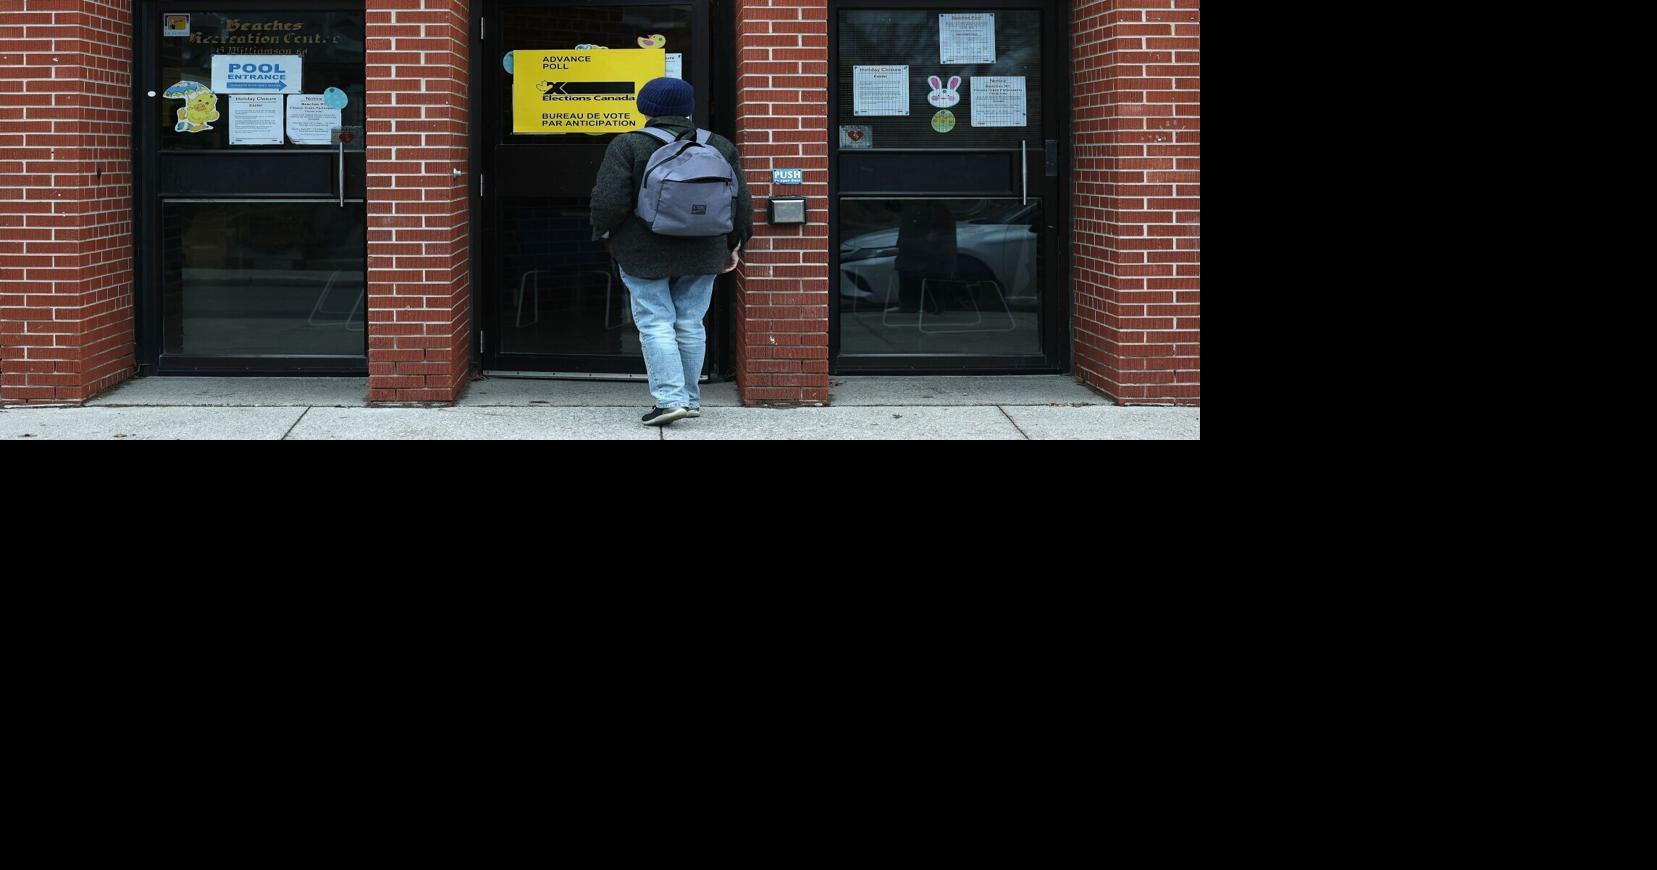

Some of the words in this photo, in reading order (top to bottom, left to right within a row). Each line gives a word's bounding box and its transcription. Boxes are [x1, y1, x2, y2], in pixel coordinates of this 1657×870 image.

[224, 19, 305, 32] Beaches
[188, 32, 280, 44] Recreation
[283, 32, 341, 44] Cente
[228, 63, 286, 74] POOL
[542, 94, 592, 102] Elections
[593, 94, 635, 102] Canada
[542, 112, 584, 120] BUREAU
[586, 112, 600, 120] DE
[603, 112, 631, 120] VOTE
[774, 170, 801, 179] PUSH
